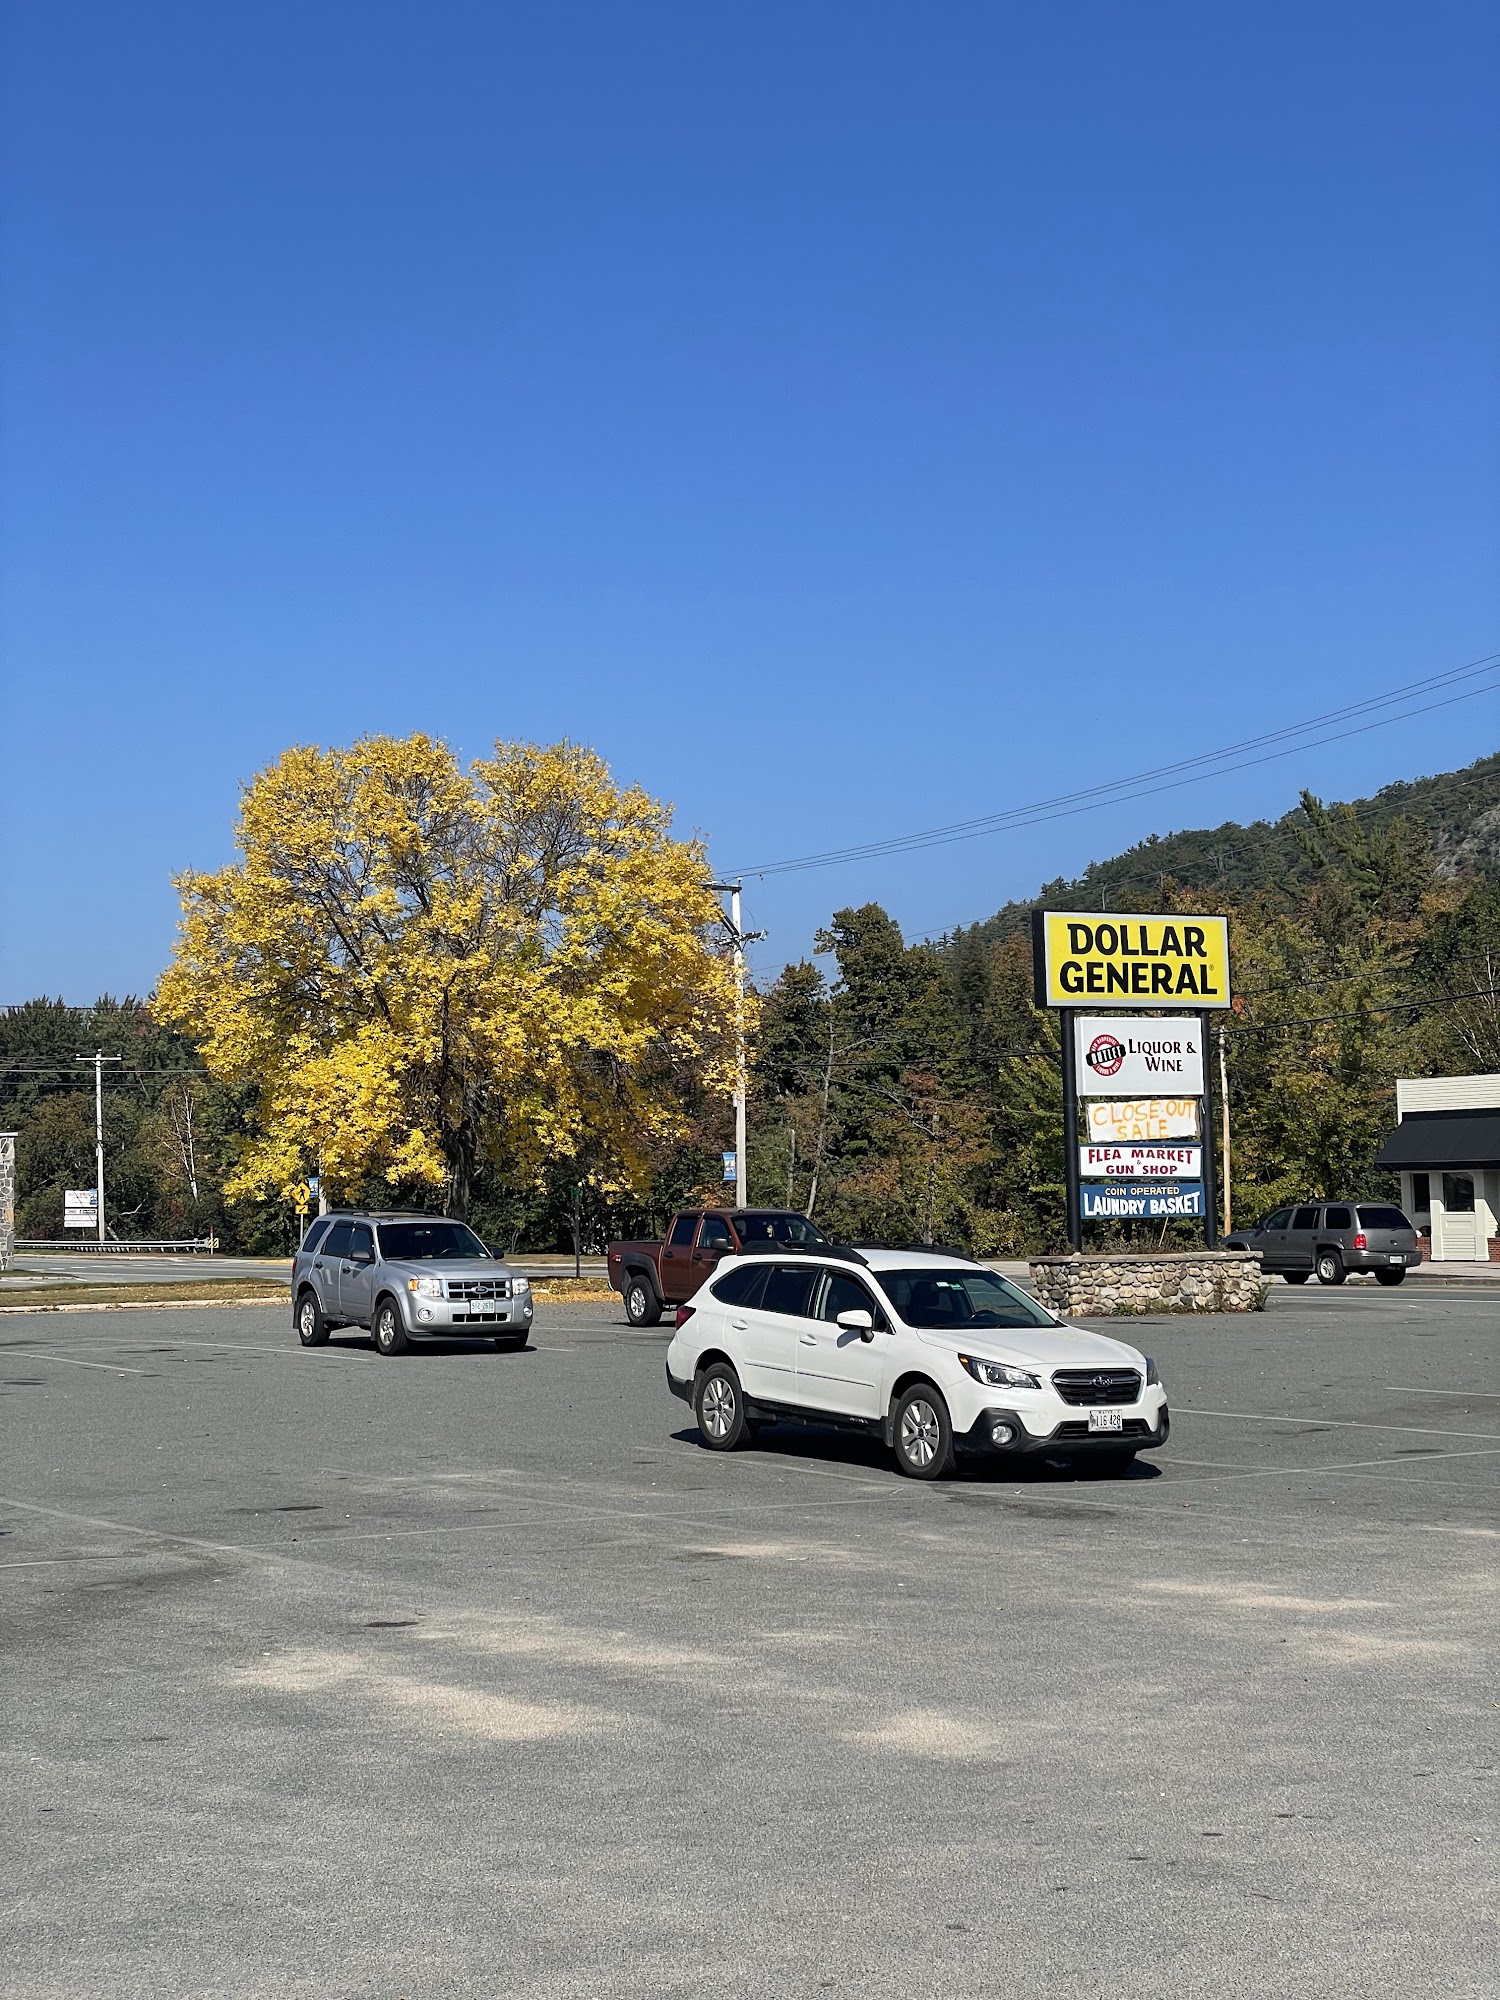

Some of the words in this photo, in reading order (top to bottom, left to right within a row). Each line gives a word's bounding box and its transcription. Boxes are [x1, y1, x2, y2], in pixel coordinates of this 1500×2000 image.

[1067, 923, 1208, 958] DOLLAR
[1059, 960, 1218, 995] GENERAL
[1091, 1045, 1122, 1065] OUTLET
[1128, 1039, 1182, 1056] LIQUOR
[1186, 1041, 1197, 1054] &
[1145, 1056, 1184, 1072] WINE
[1093, 1100, 1160, 1126] CLOSE
[1165, 1100, 1196, 1119] OUT
[1116, 1119, 1169, 1140] SALE
[1088, 1149, 1121, 1165] FLEA
[1131, 1149, 1193, 1165] MARKET
[1105, 1165, 1135, 1175] GUN
[1142, 1165, 1178, 1175] SHOP
[1105, 1188, 1127, 1196] COIN
[1130, 1187, 1180, 1196] OPERATED
[1083, 1192, 1147, 1216] LAUNDRY
[1150, 1191, 1200, 1215] BASKET
